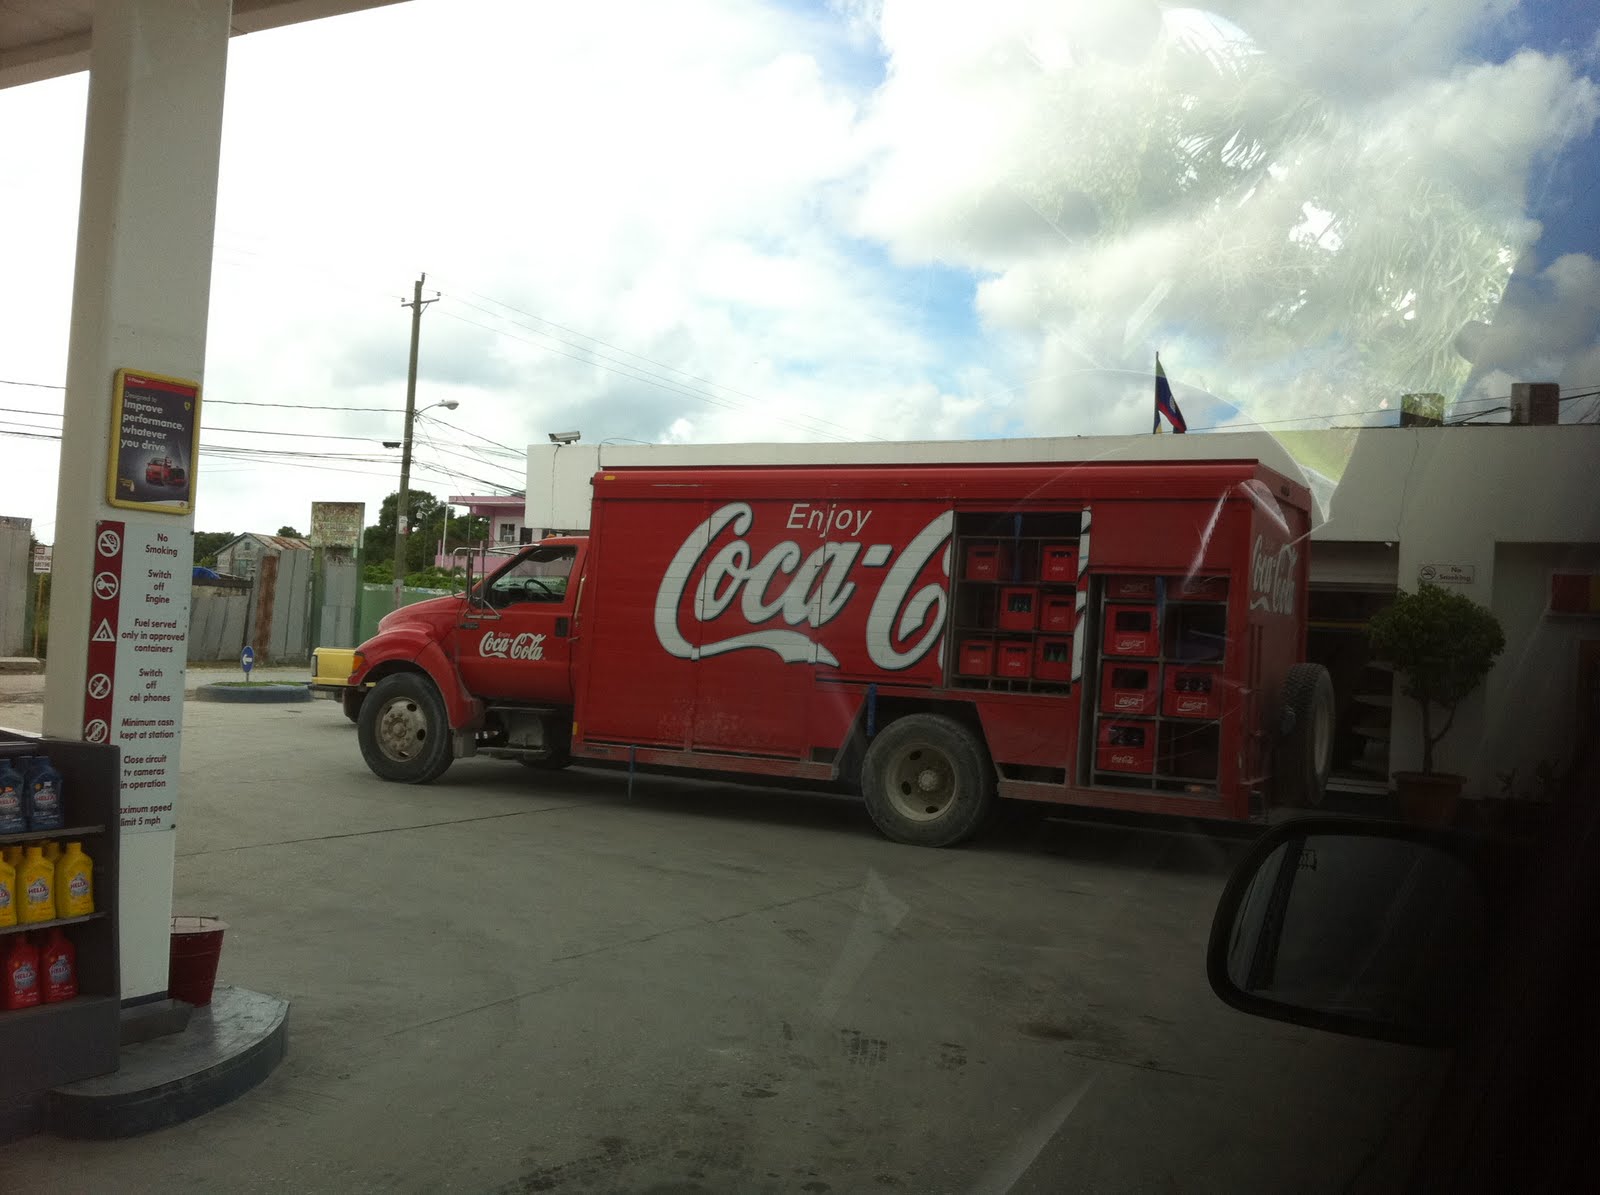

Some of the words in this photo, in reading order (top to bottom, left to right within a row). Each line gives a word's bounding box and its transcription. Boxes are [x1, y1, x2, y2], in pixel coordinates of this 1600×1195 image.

[124, 399, 163, 414] Improve
[122, 413, 185, 431] performance,
[122, 425, 167, 440] whatever
[120, 438, 139, 449] you
[142, 440, 166, 452] drive
[786, 503, 872, 538] Enjoy
[157, 533, 168, 542] No
[145, 544, 178, 557] Smoking
[147, 569, 172, 579] Switch
[153, 582, 165, 591] off
[145, 594, 170, 605] Engine
[134, 618, 150, 627] Fuel
[151, 618, 177, 628] served
[121, 631, 139, 640] only
[140, 631, 148, 640] in
[149, 632, 185, 642] approved
[134, 644, 173, 653] containers
[479, 631, 547, 660] Coca-Cola
[139, 668, 163, 677] Switch
[145, 680, 157, 689] off
[143, 693, 171, 703] phones
[121, 718, 156, 727] Minimum
[119, 730, 138, 741] kept
[139, 731, 147, 739] at
[148, 730, 174, 739] station
[124, 755, 144, 764] Close
[145, 754, 167, 763] circuit
[124, 769, 132, 777] tv
[133, 768, 165, 777] cameras
[120, 780, 128, 789] in
[129, 779, 166, 790] operation
[119, 805, 148, 814] aximum
[150, 803, 173, 813] speed
[120, 817, 137, 826] limit
[138, 816, 143, 825] 5
[144, 815, 161, 827] mph
